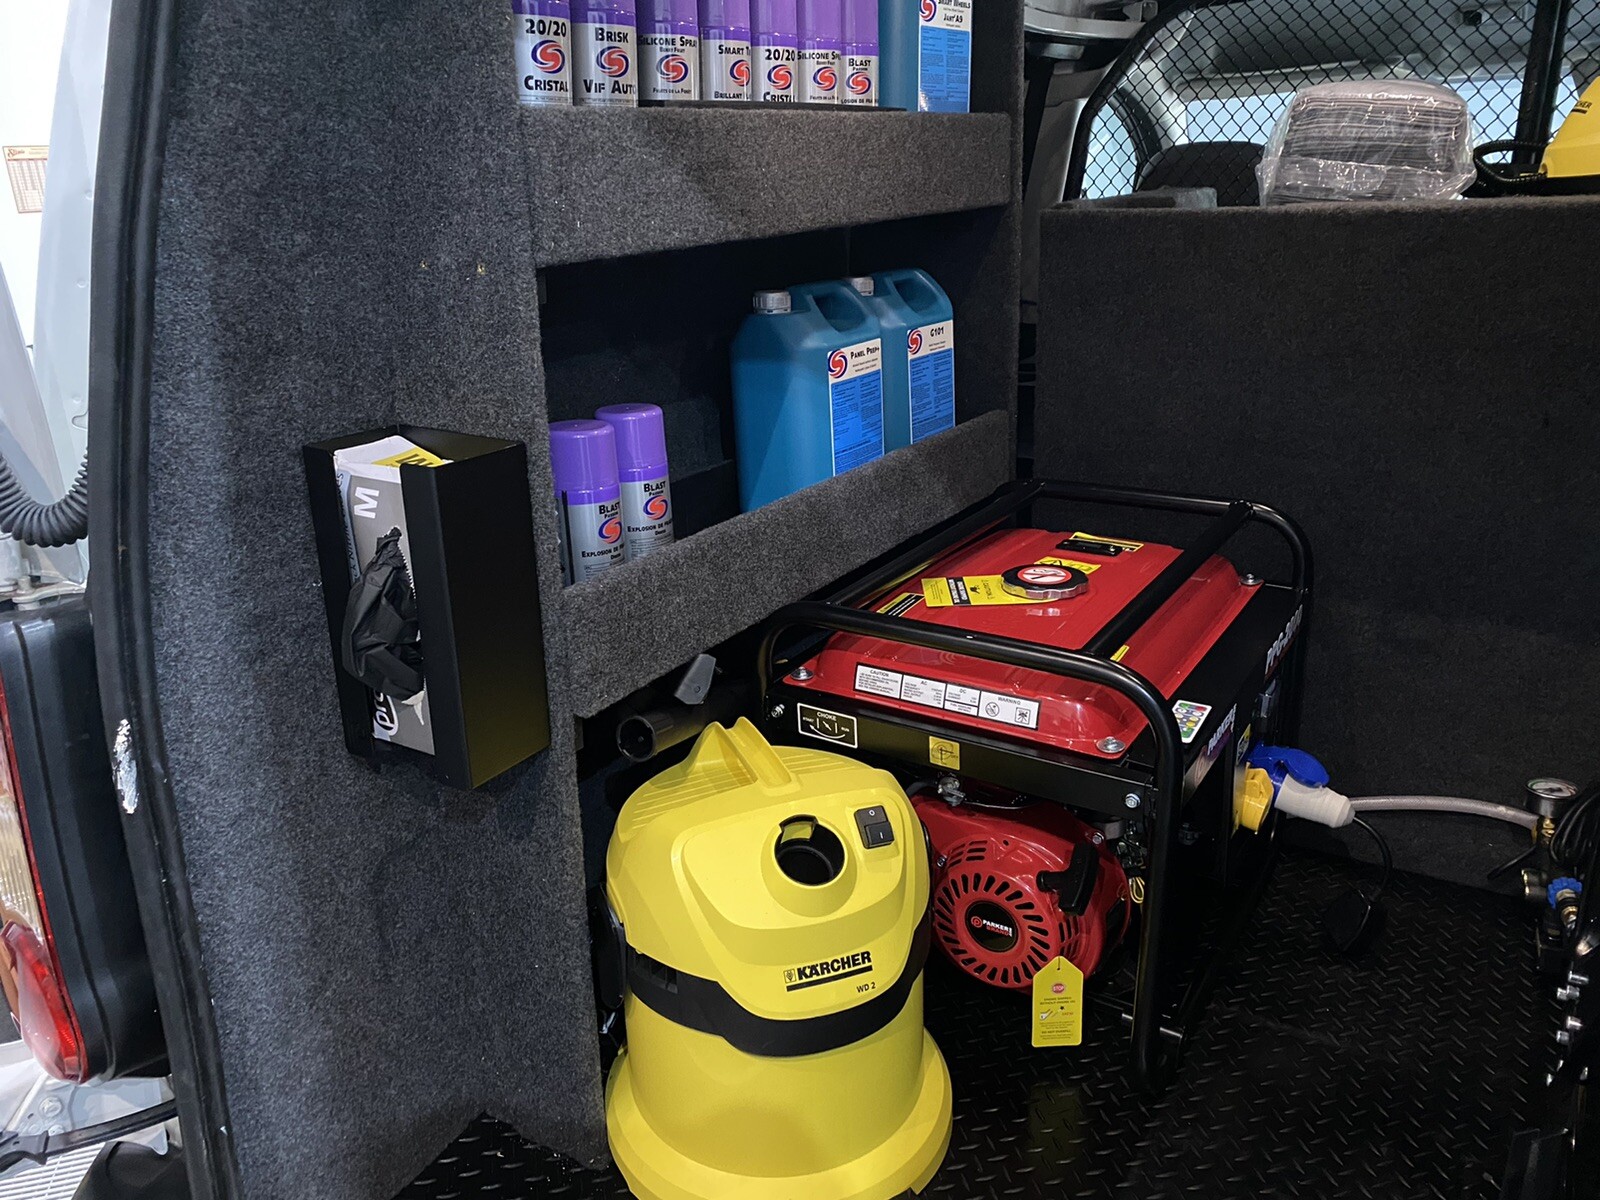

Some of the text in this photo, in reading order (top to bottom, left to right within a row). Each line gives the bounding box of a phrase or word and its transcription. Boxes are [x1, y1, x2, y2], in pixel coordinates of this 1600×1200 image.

[525, 18, 567, 37] 20/20
[595, 27, 629, 43] BRISK
[680, 36, 698, 48] SPRA
[718, 44, 744, 55] SMART
[765, 48, 795, 62] 20/20
[797, 50, 830, 61] SILICONE
[848, 58, 872, 67] BLAST
[583, 79, 606, 94] VIF
[714, 91, 743, 100] BRILLANT
[850, 349, 866, 360] PANEL
[643, 481, 666, 493] BLAST
[353, 486, 380, 519] M
[599, 502, 621, 515] BLAST
[627, 522, 657, 533] EXPLOSION
[581, 547, 612, 558] EXPLOSION
[997, 696, 1022, 706] WARNING
[817, 711, 837, 721] CHOKE
[983, 919, 1009, 931] PARKER
[797, 950, 872, 981] KÄRCHER
[856, 981, 877, 993] WD 2
